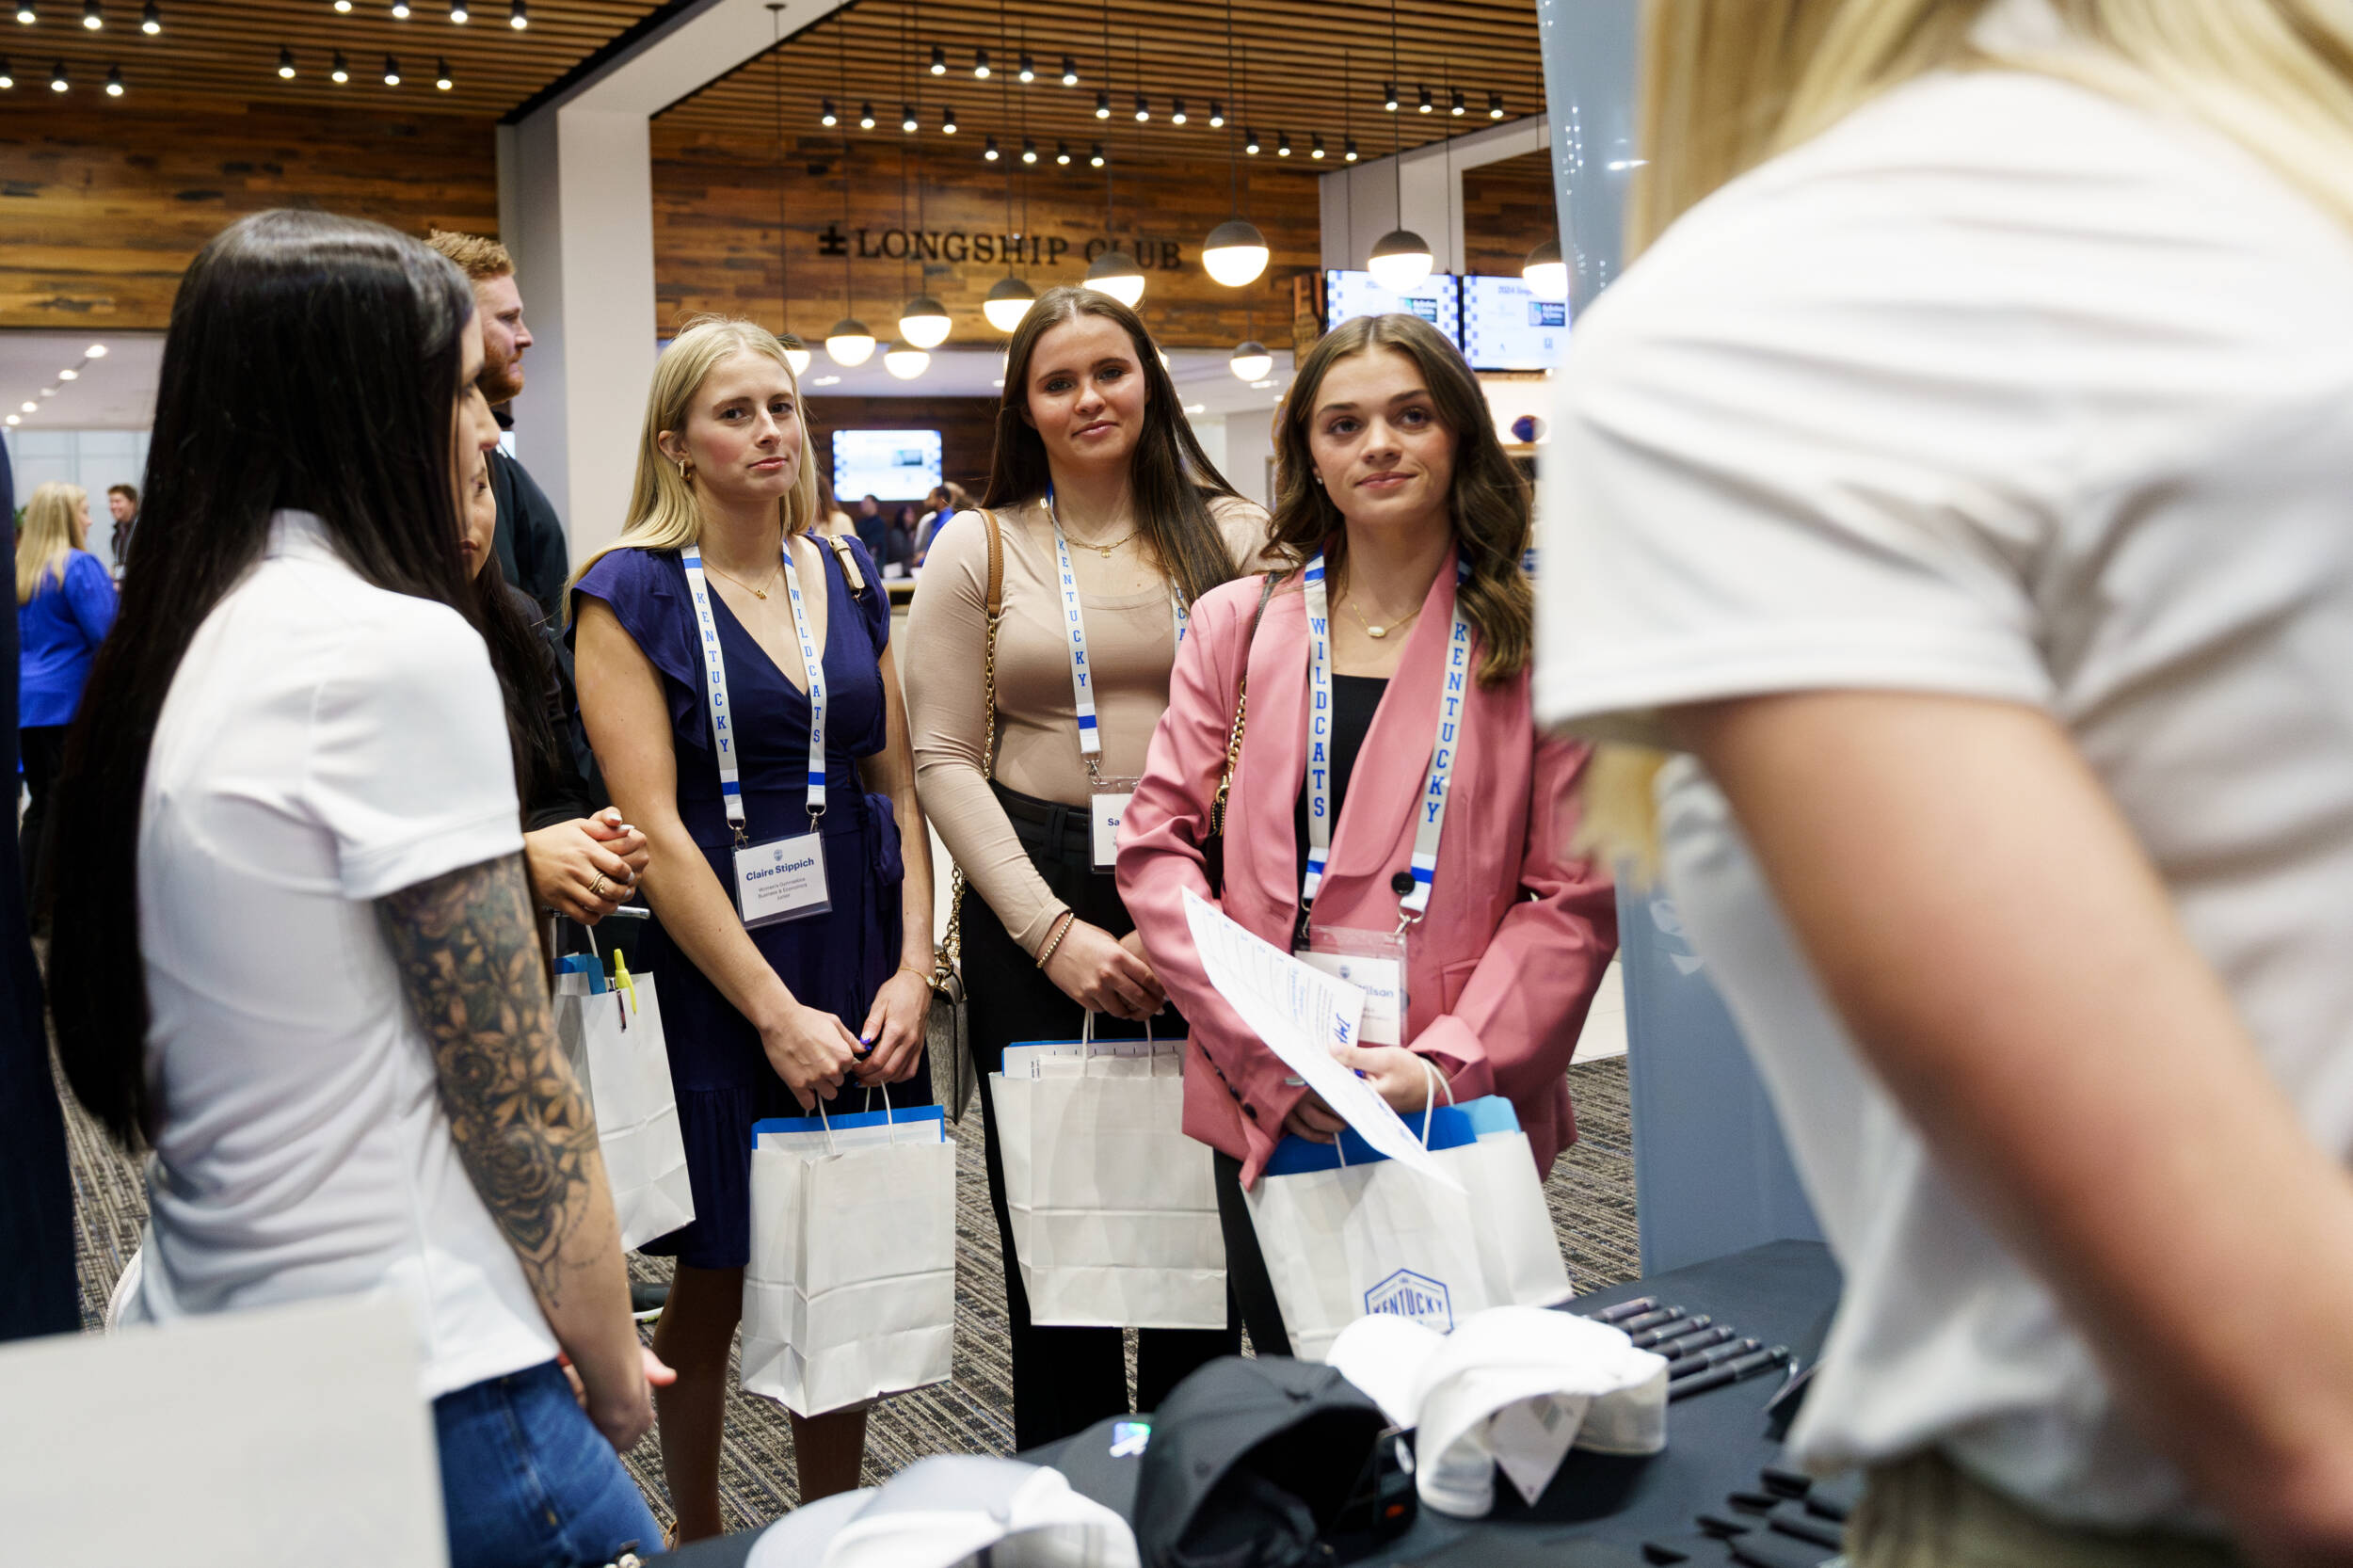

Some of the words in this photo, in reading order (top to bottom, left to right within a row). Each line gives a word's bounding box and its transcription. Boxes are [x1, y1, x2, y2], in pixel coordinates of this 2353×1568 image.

[856, 227, 1069, 266] LONGSHIP
[696, 591, 730, 754] KENTUCKY
[790, 587, 822, 744] WILDCATS
[1057, 537, 1087, 688] KENTUCKY
[1310, 616, 1327, 819] WILDCATS
[1426, 621, 1467, 824] KENTUCKY
[745, 869, 774, 881] Claire
[776, 857, 815, 873] Stippich
[1373, 1287, 1443, 1316] KENTUCKY
